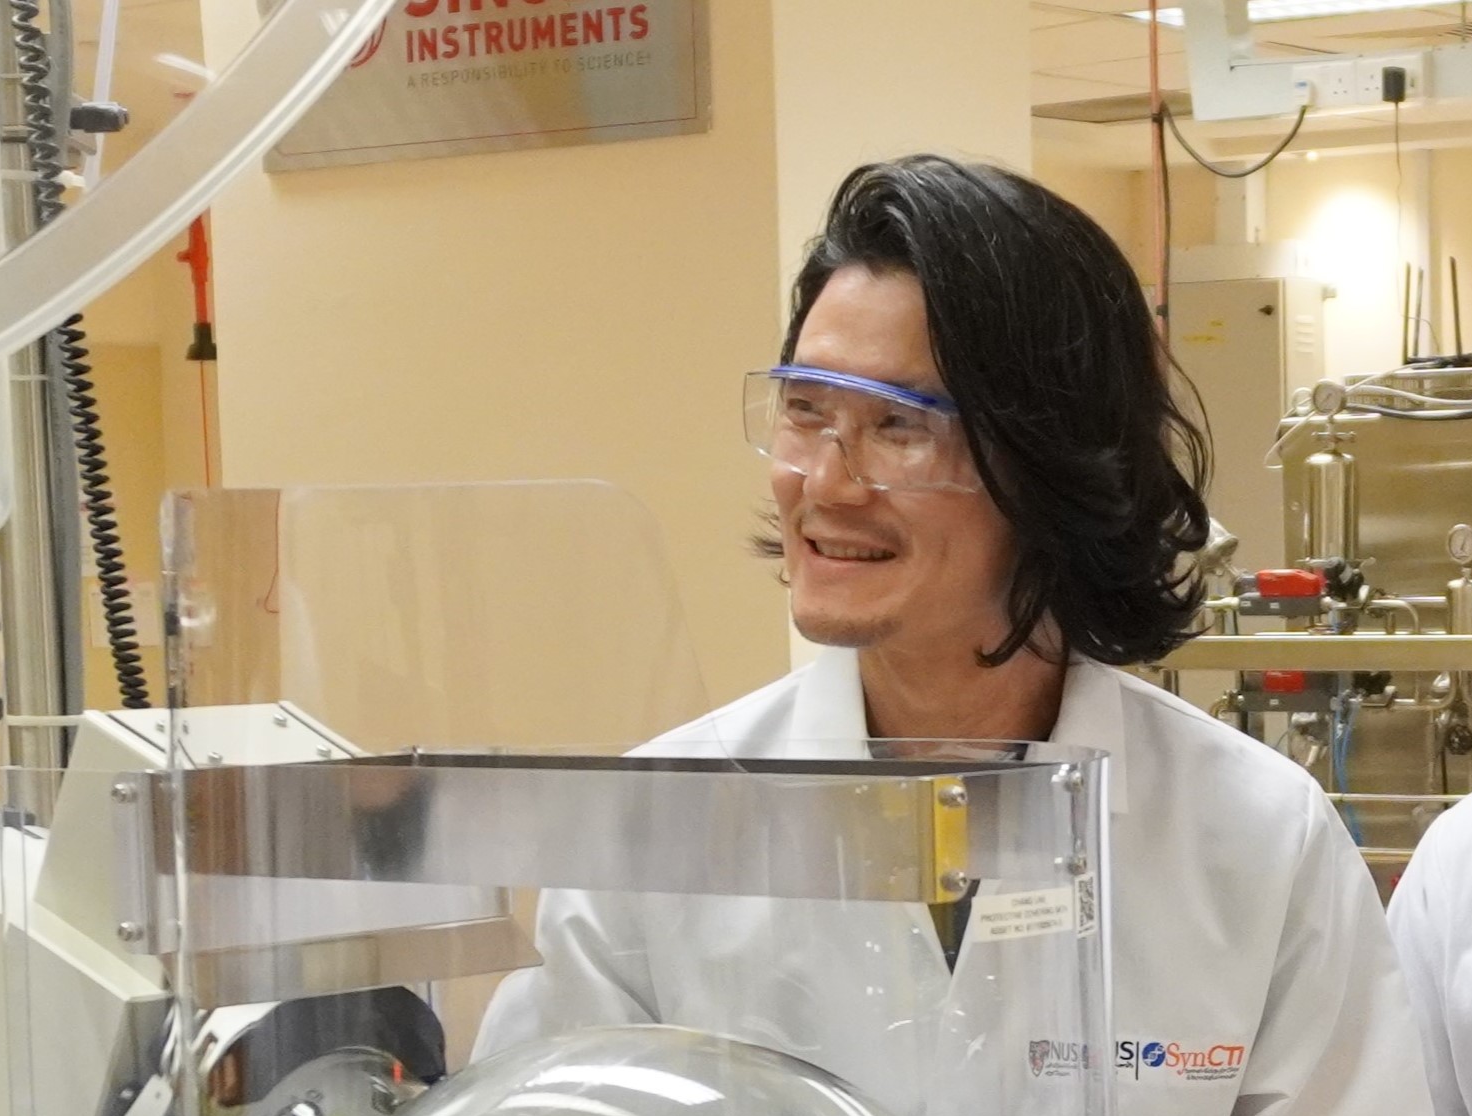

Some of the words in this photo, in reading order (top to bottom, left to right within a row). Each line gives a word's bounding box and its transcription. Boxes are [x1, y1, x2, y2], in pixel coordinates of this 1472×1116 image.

[406, 4, 649, 63] INSTRUMENTS
[407, 75, 417, 89] A
[420, 61, 546, 87] RESPONSIBILITY
